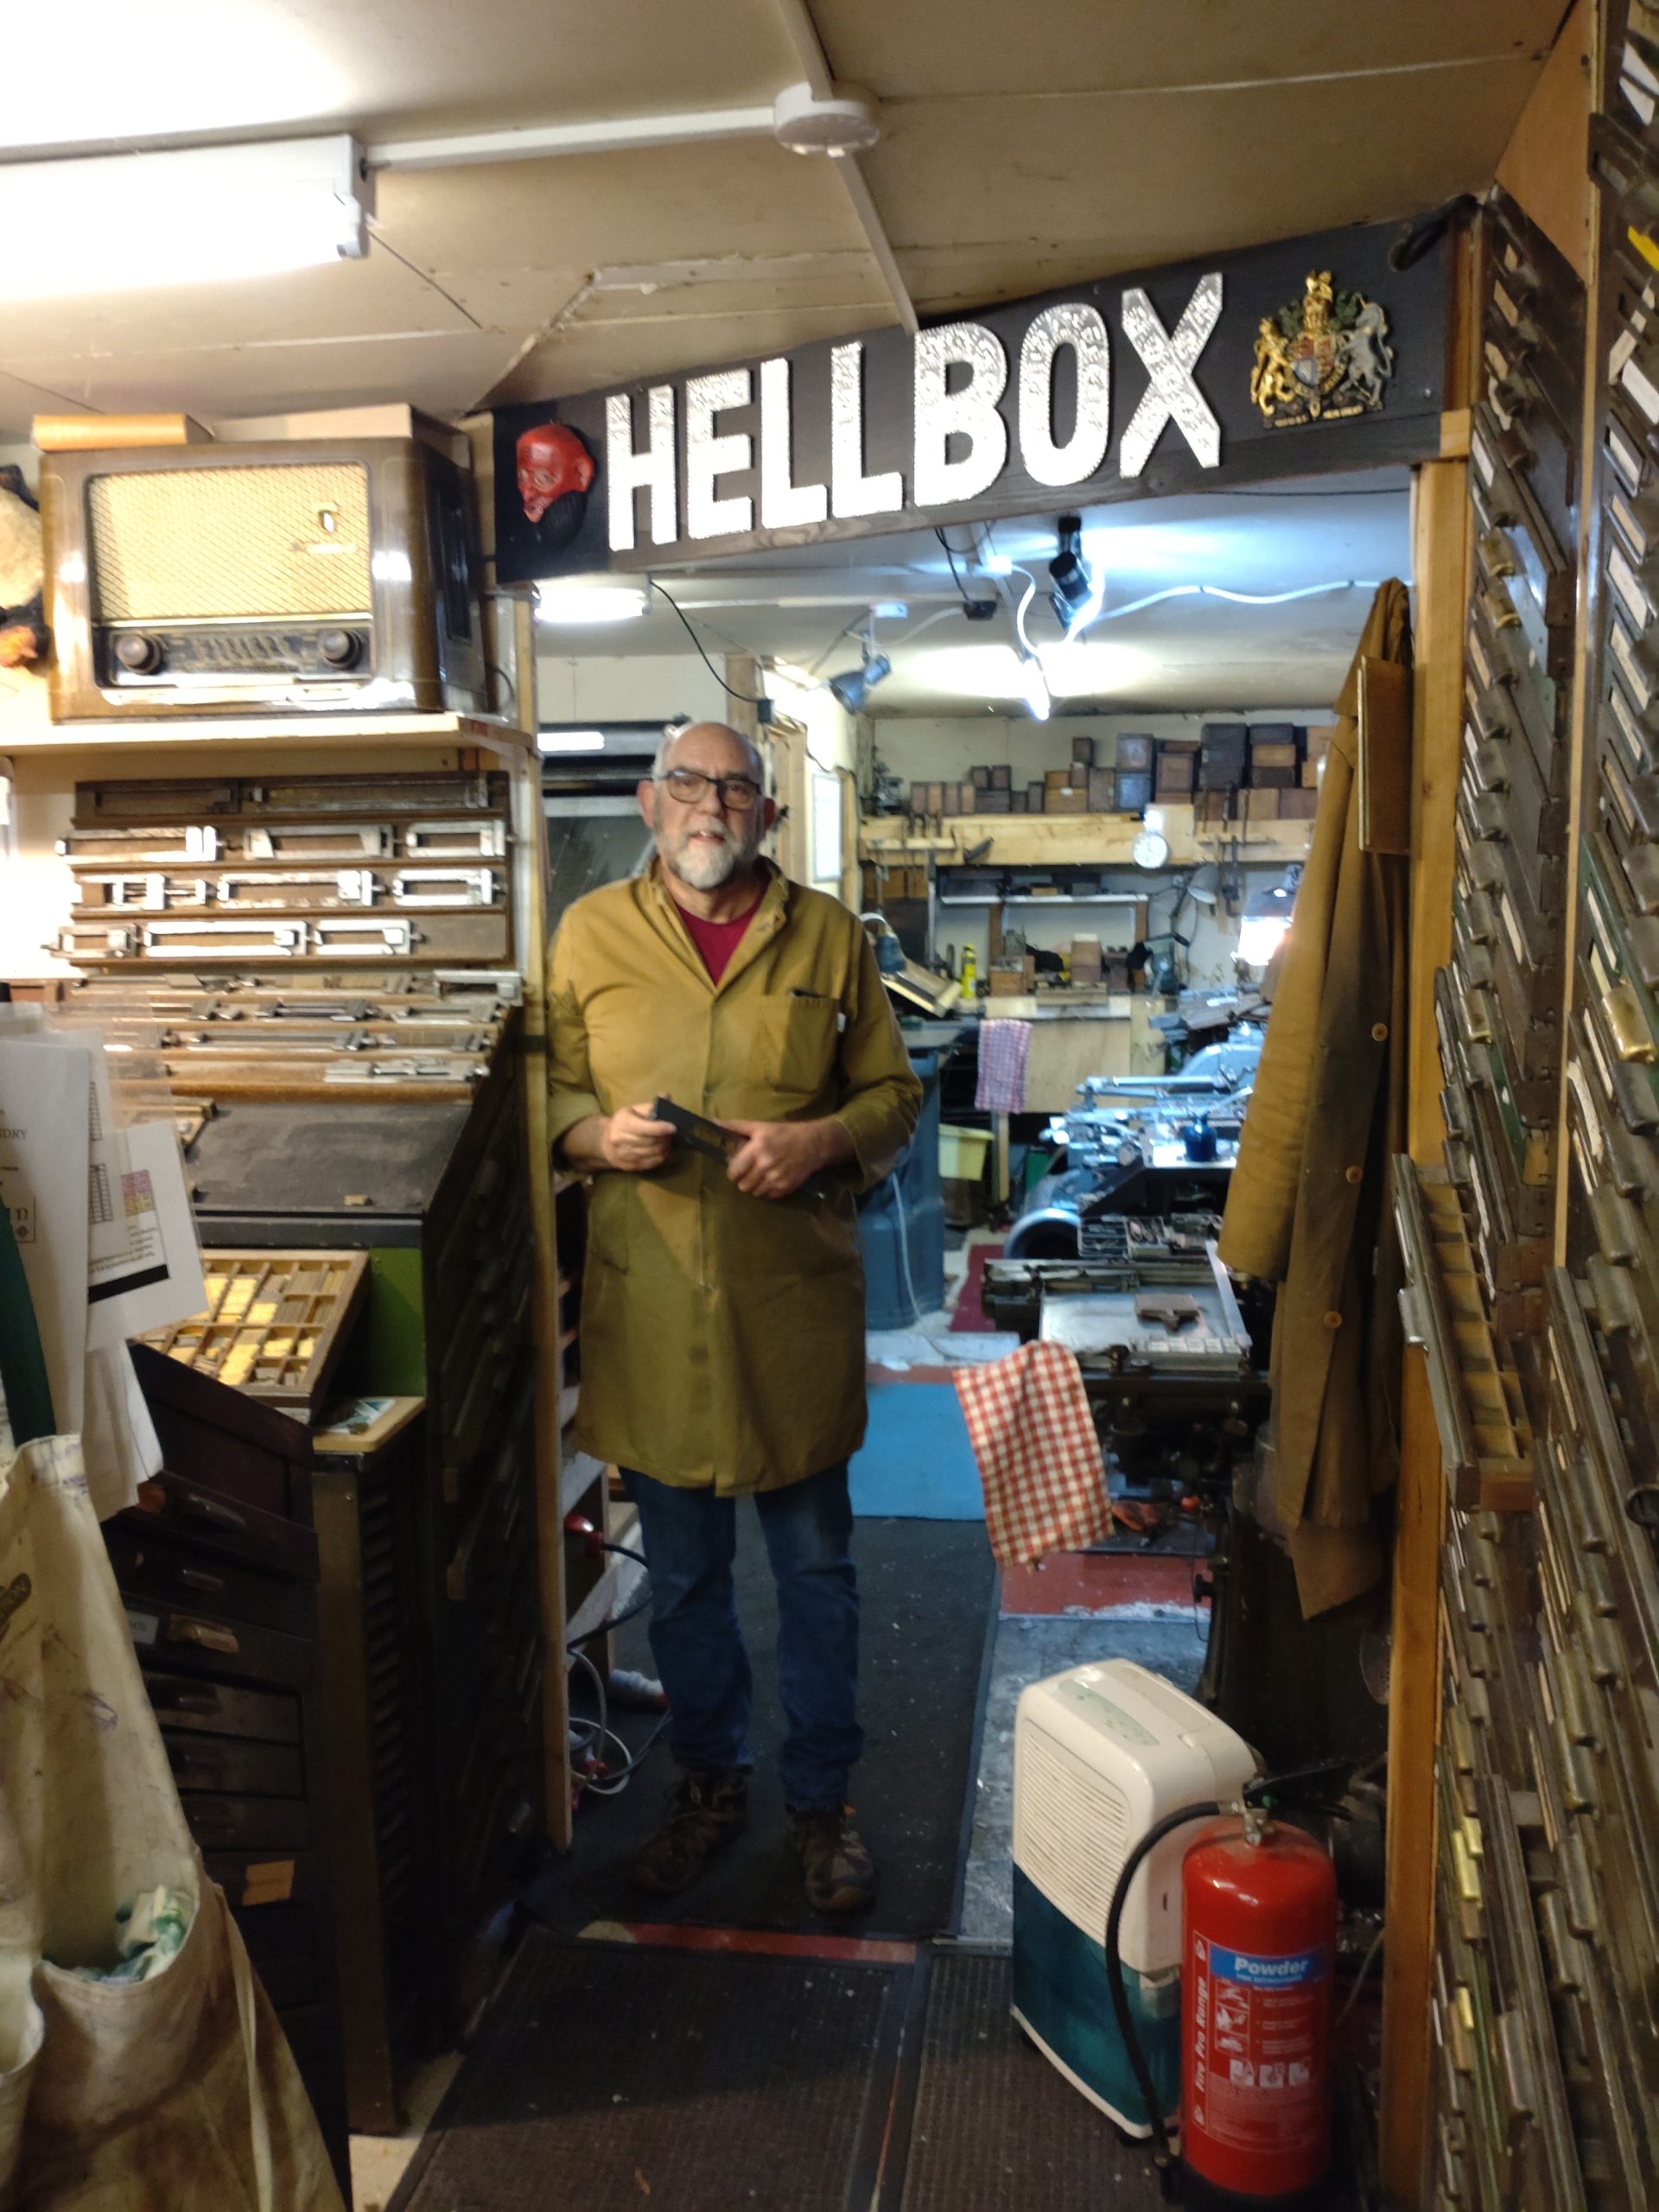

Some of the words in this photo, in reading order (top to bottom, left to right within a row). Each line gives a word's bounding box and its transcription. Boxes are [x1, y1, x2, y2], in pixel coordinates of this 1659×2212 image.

[605, 271, 1224, 552] HELLBOX
[1234, 1956, 1309, 1976] Powder
[1195, 1975, 1210, 2028] Range
[1195, 2031, 1206, 2059] Pro
[1195, 2061, 1205, 2092] Fire
